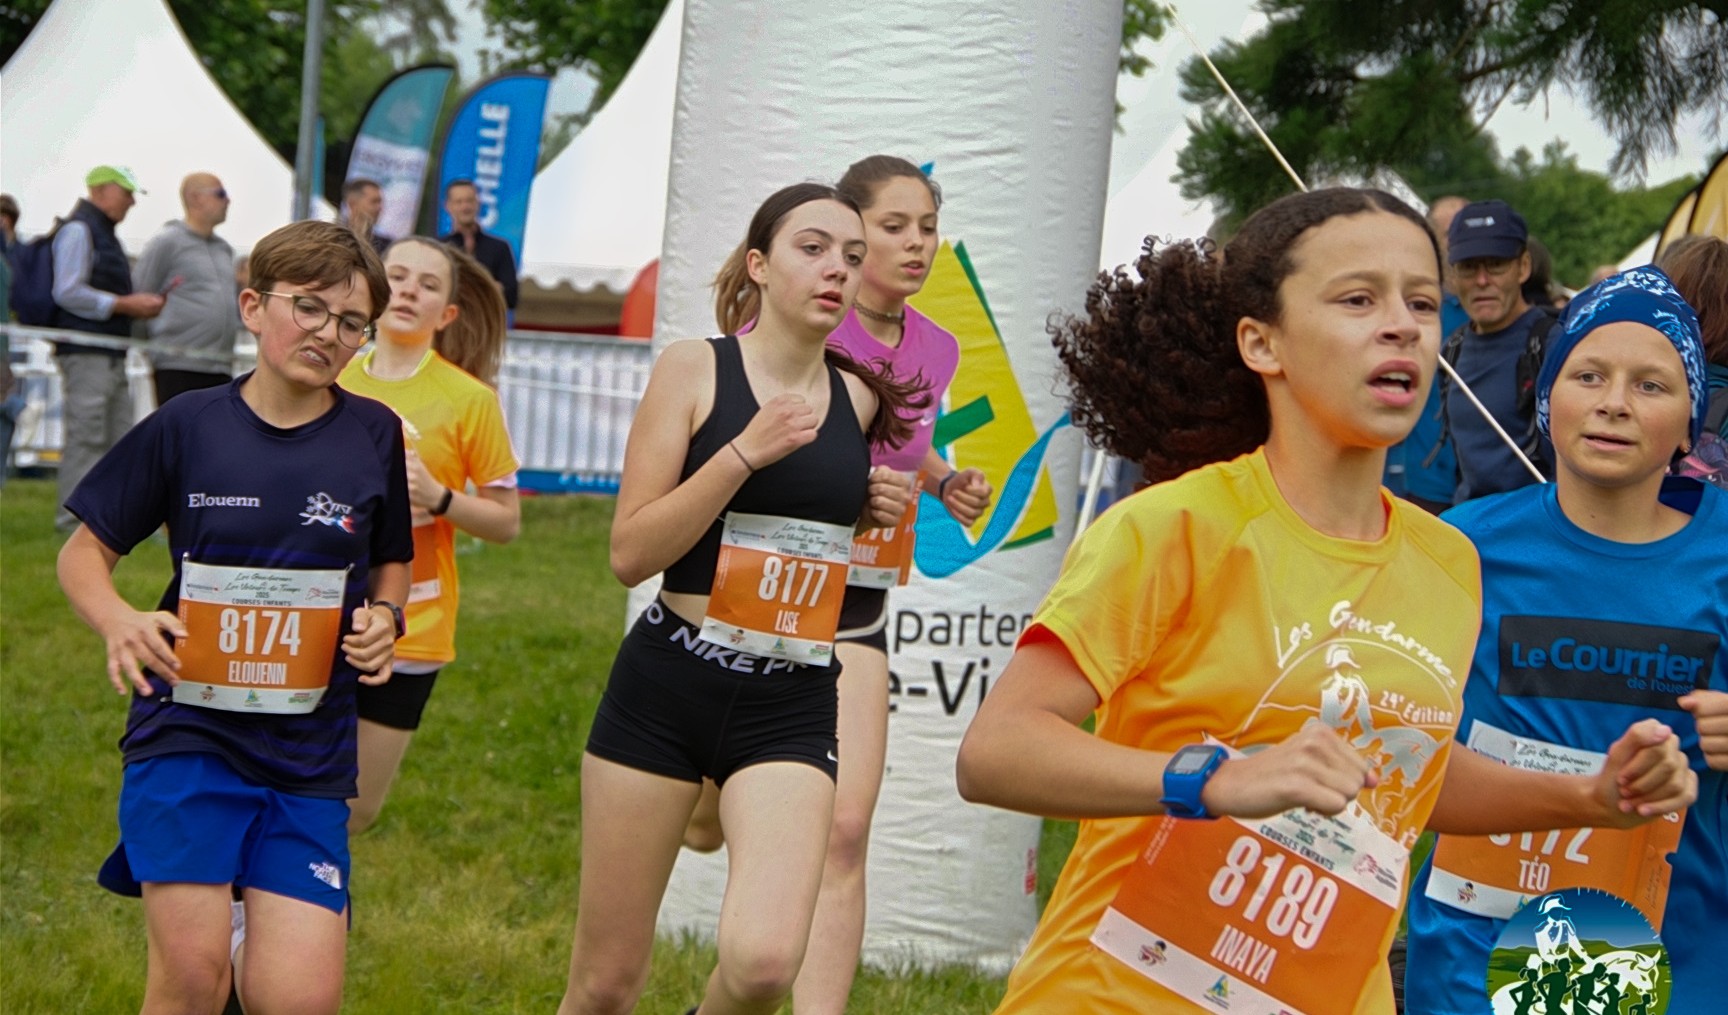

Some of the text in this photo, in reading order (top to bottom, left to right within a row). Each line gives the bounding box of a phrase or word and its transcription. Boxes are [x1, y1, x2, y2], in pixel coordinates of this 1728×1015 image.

[188, 493, 260, 508] Elouenn
[758, 556, 828, 607] 8177
[218, 608, 301, 656] 8174
[775, 610, 800, 634] LISE
[669, 626, 761, 673] NIKE
[1274, 622, 1313, 668] Les
[1511, 637, 1704, 682] Le Courrier
[228, 660, 287, 685] ELOUENN
[1627, 677, 1648, 690] de
[1403, 701, 1453, 724] Édition
[1260, 824, 1299, 851] COURSES
[1208, 836, 1338, 950] 8189
[1519, 856, 1550, 891] TÉO
[1210, 925, 1278, 984] INAYA
